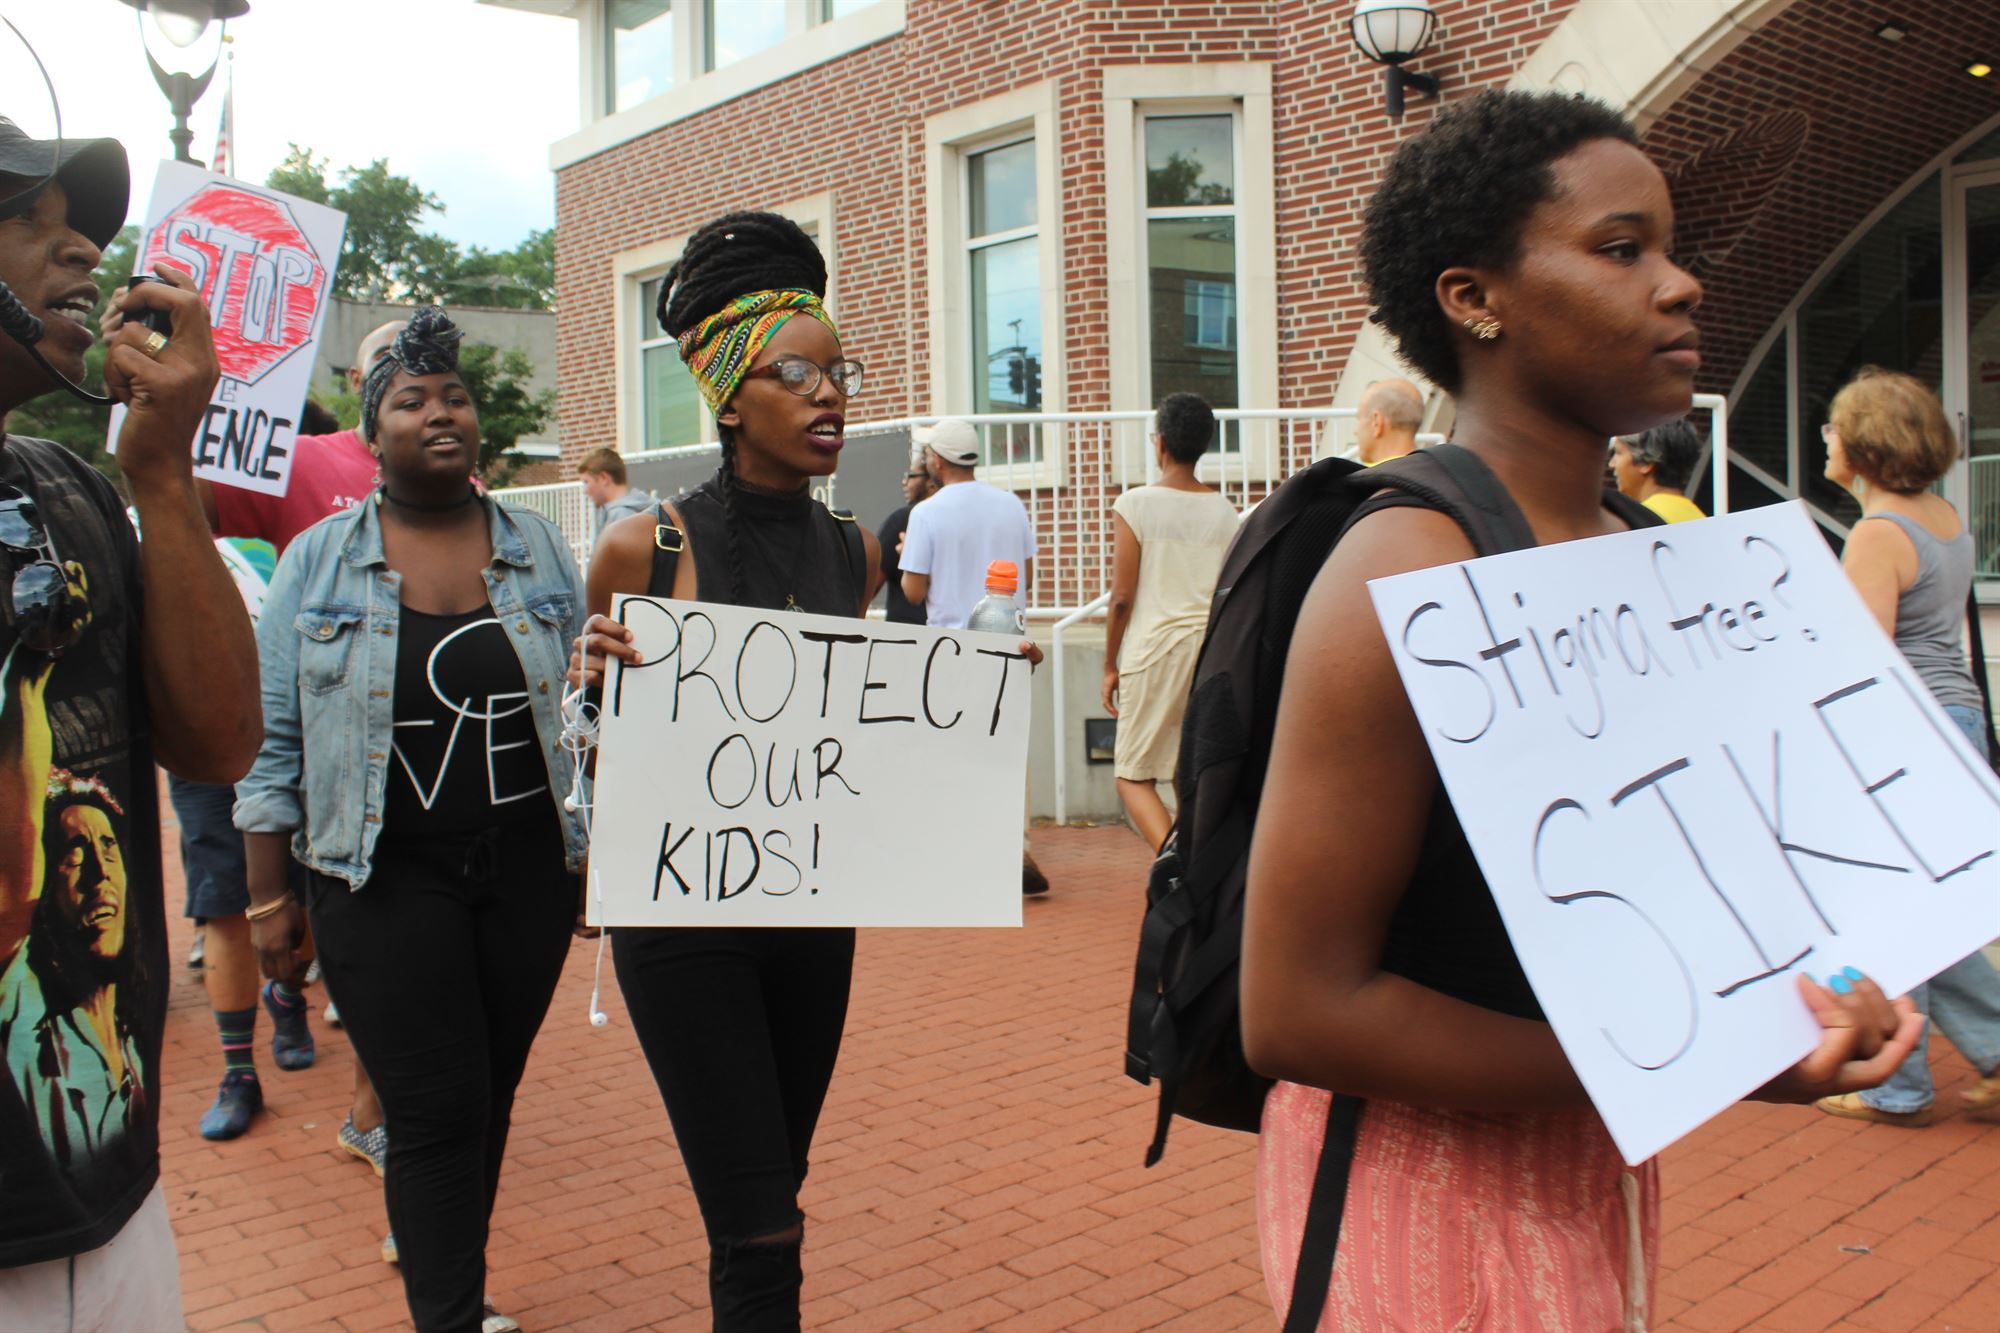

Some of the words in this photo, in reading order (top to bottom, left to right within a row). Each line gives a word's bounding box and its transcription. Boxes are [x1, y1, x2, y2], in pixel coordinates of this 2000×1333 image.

[164, 219, 314, 345] STOP
[192, 403, 292, 481] ENCE
[613, 597, 1027, 737] PROTECT
[1402, 564, 1675, 744] Stigma
[1651, 536, 1820, 671] free?
[707, 733, 861, 809] OUR
[652, 822, 820, 902] KIDS!
